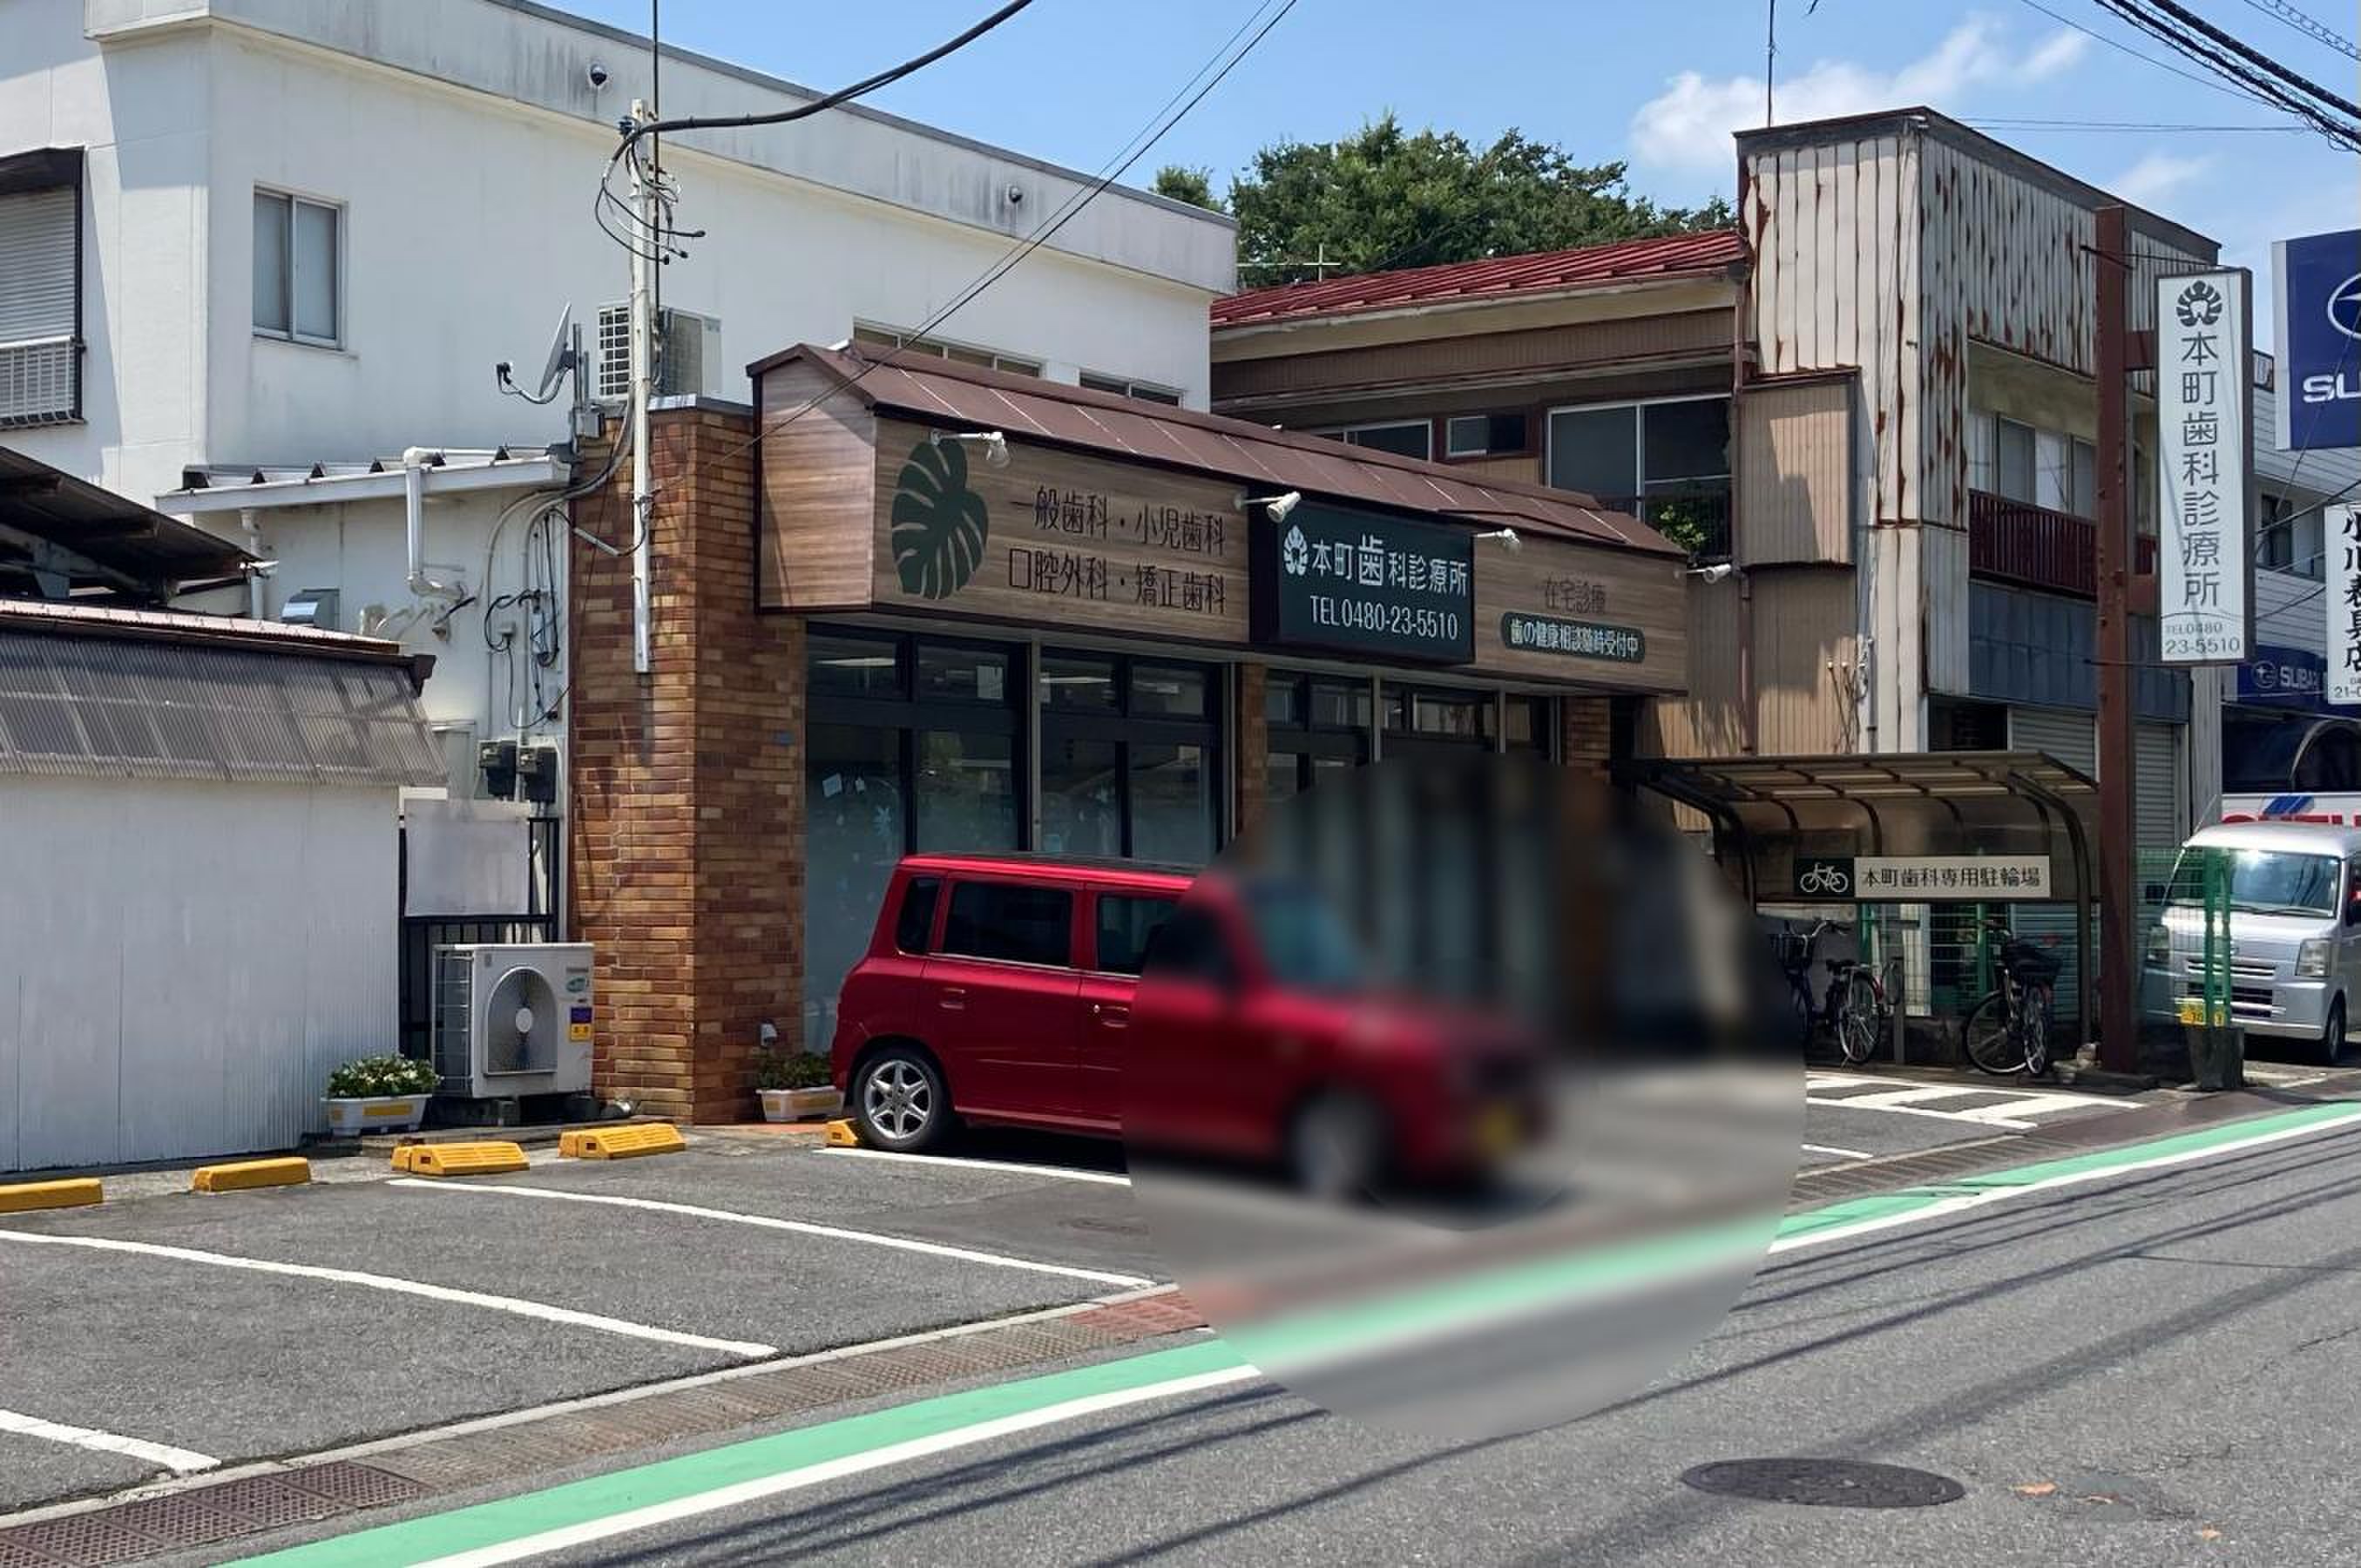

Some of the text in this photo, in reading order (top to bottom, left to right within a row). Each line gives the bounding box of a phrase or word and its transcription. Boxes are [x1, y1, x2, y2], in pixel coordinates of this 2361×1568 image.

[2181, 331, 2220, 607] 本町歯科診療所
[1311, 532, 1467, 597] 本町歯科診療所
[2164, 637, 2240, 654] 23-5510
[1864, 867, 2041, 888] 本町歯科専用駐輪場
